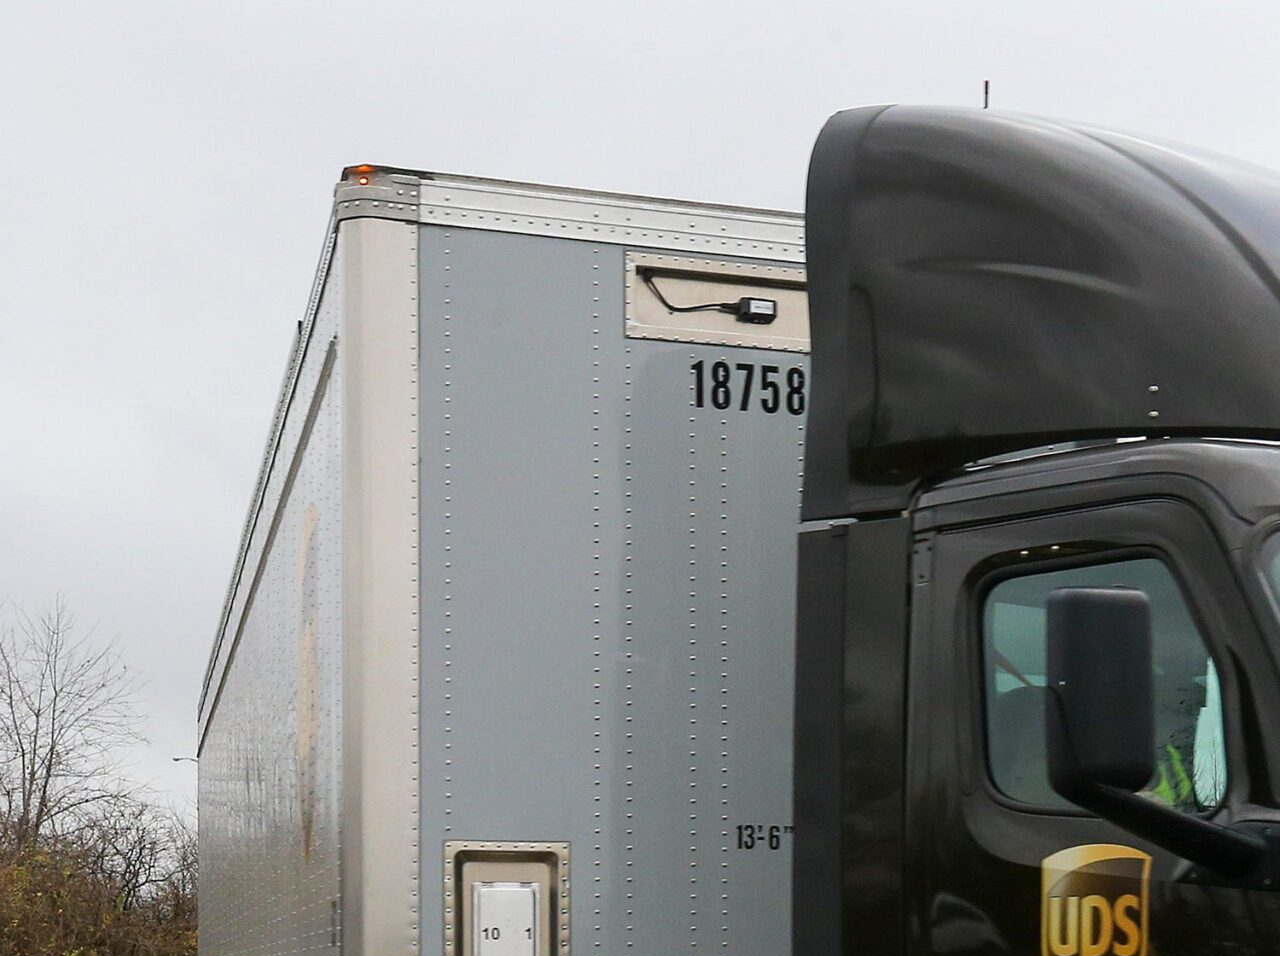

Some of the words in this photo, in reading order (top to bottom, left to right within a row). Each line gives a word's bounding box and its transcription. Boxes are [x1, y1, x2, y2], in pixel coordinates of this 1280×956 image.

[690, 360, 806, 416] 18758
[481, 927, 501, 941] 10
[524, 927, 533, 940] 1
